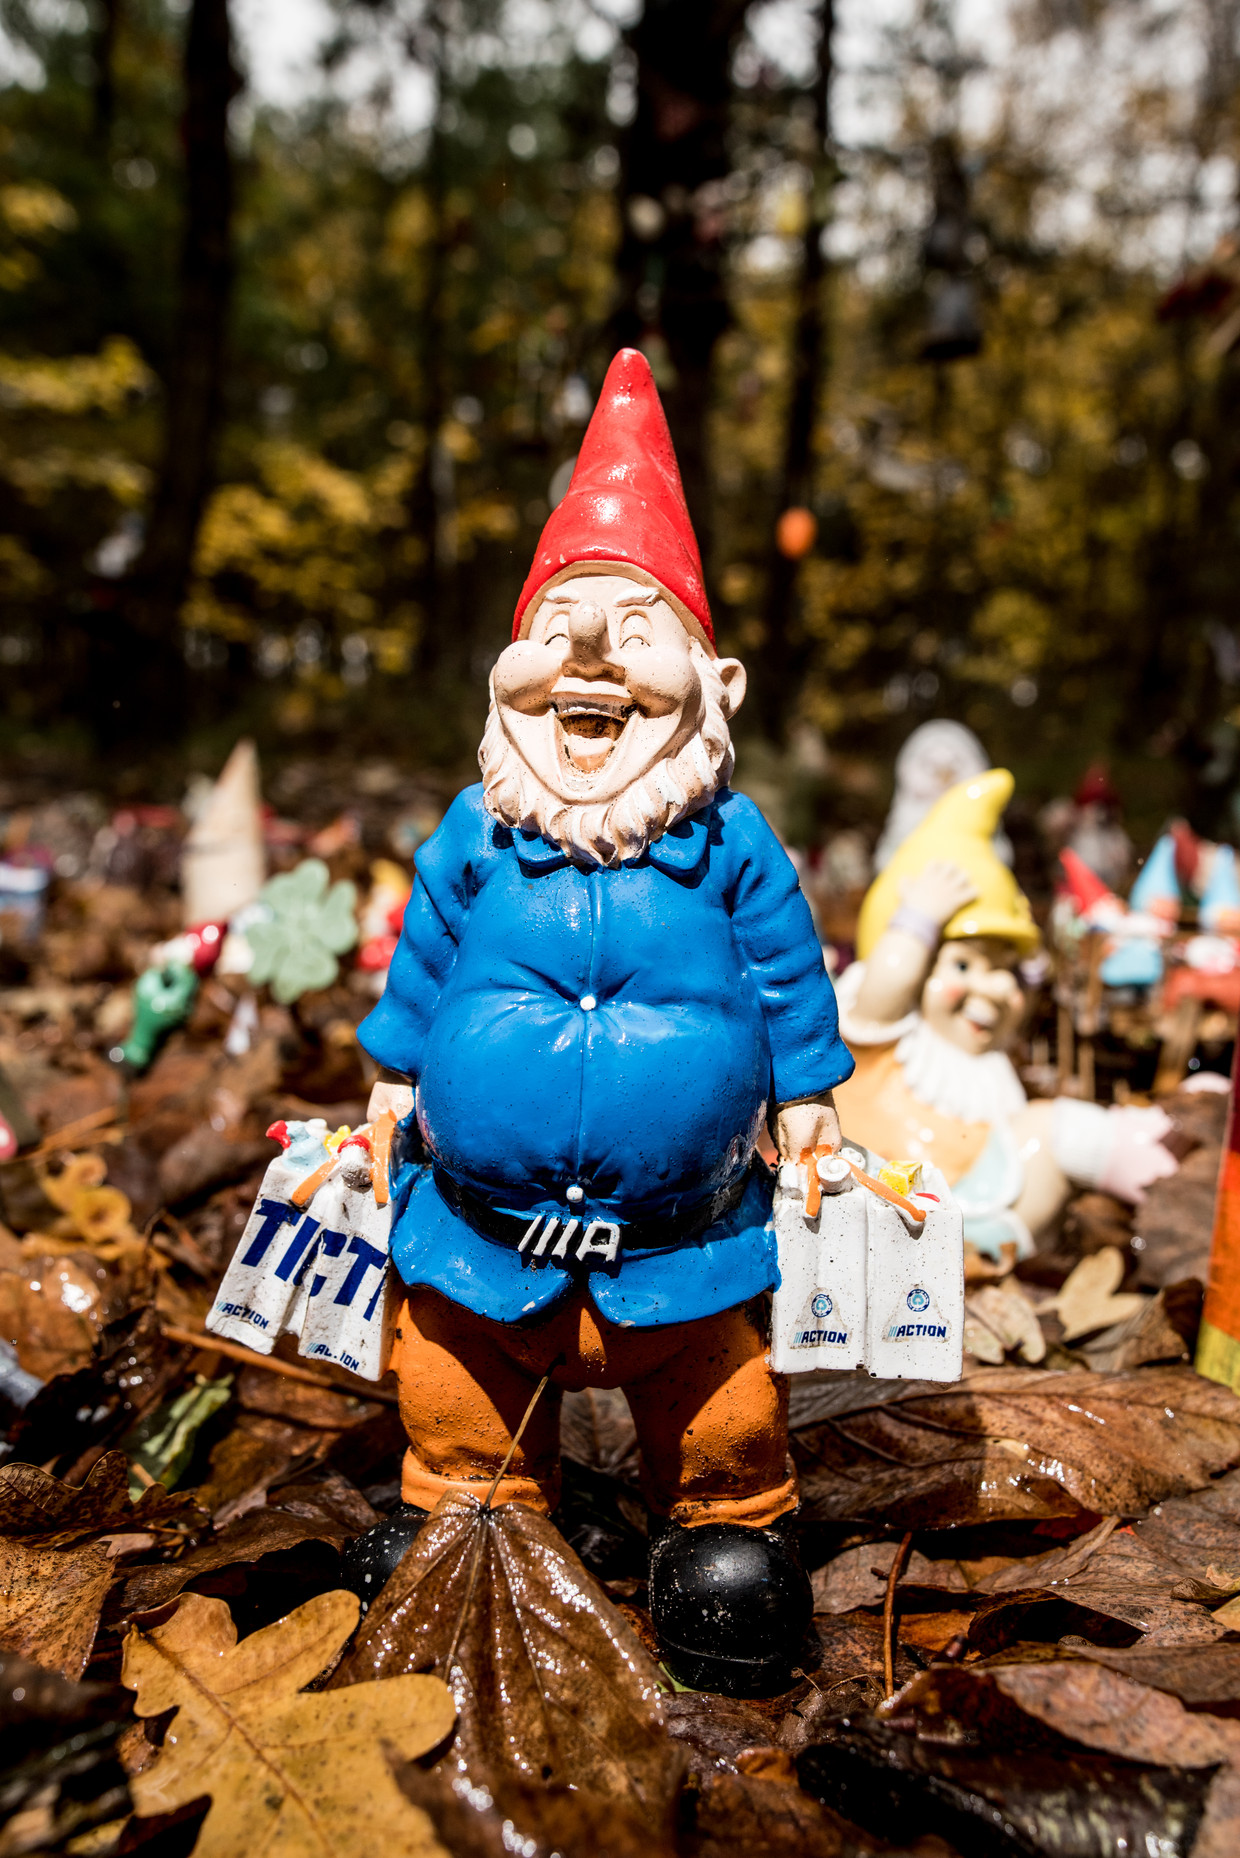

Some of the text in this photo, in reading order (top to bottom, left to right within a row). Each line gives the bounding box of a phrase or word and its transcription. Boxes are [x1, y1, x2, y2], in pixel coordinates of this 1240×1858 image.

[221, 1303, 270, 1330] ACTION
[800, 1330, 848, 1344] ACTION
[895, 1324, 947, 1338] ACTION
